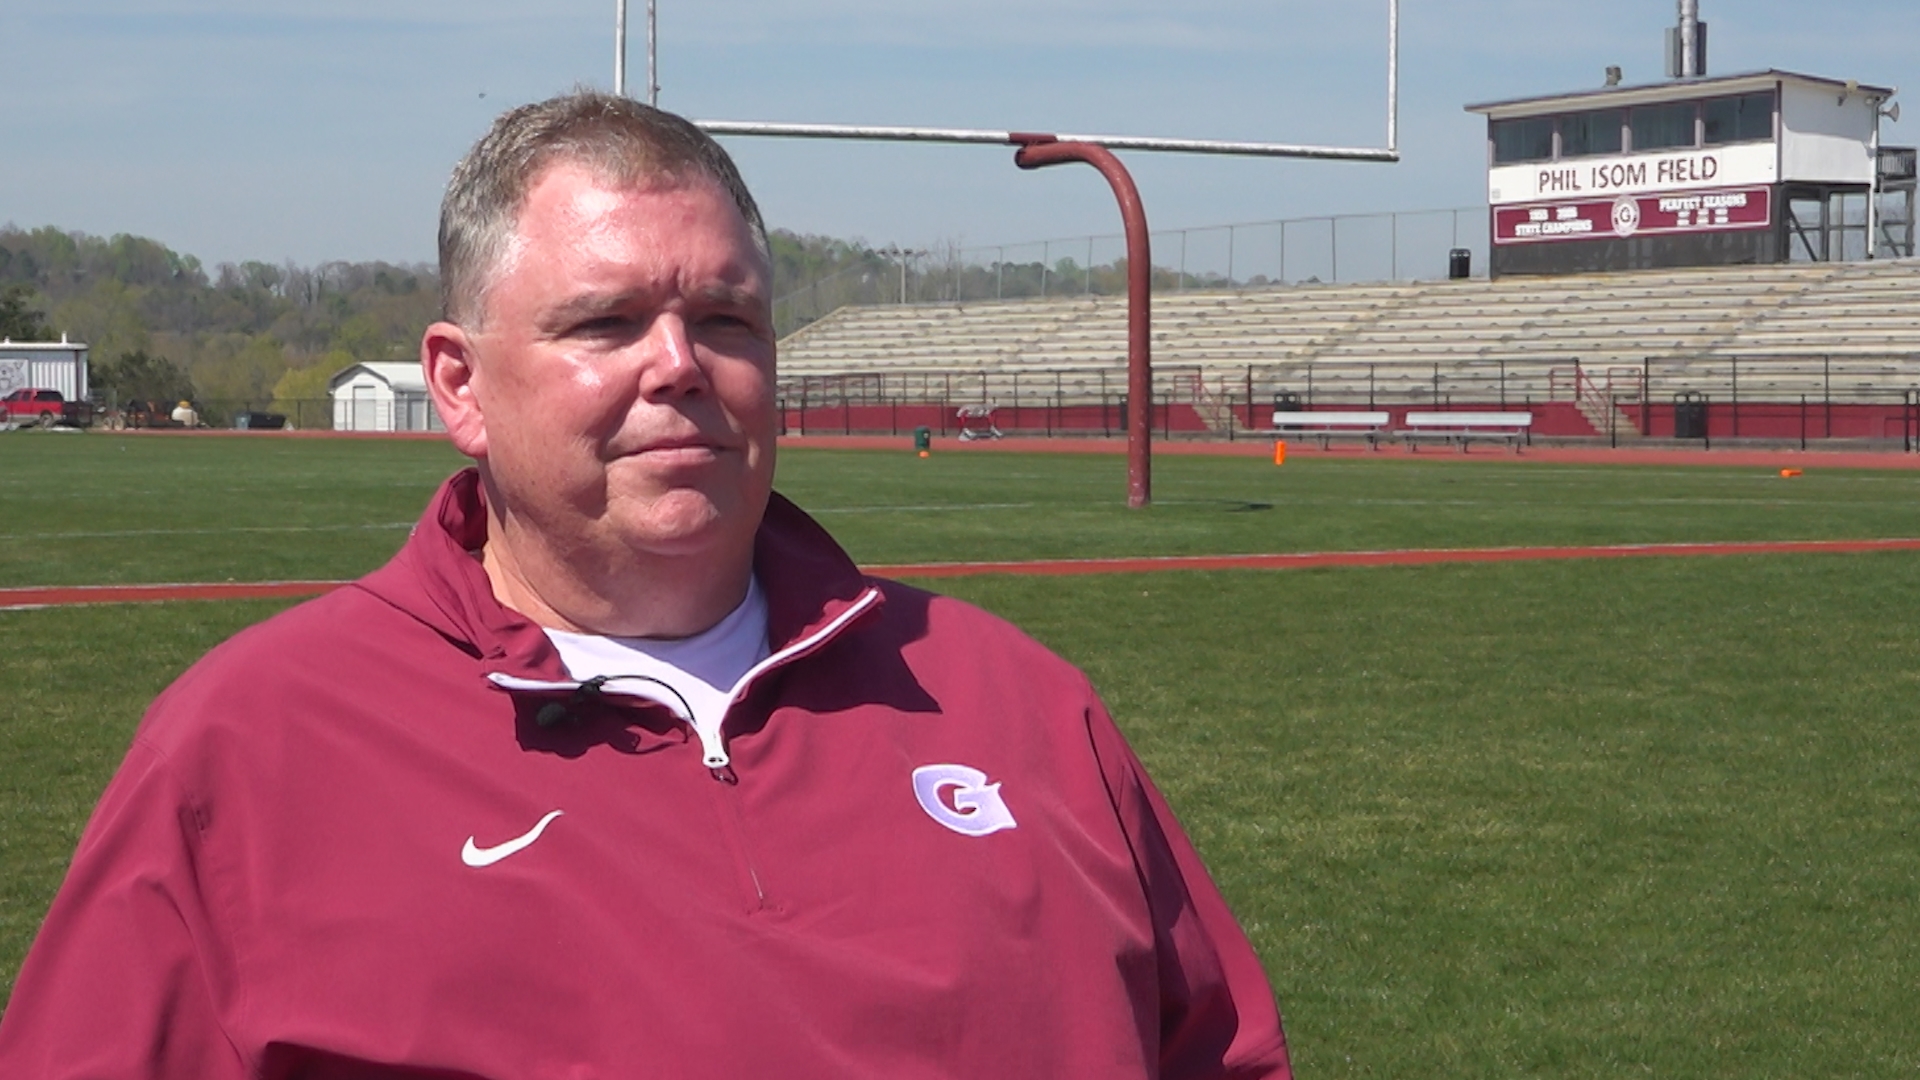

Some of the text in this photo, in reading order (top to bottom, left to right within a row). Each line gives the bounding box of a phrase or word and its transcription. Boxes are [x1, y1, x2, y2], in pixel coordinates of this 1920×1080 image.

[1539, 156, 1718, 193] PHIL ISOM FIELD
